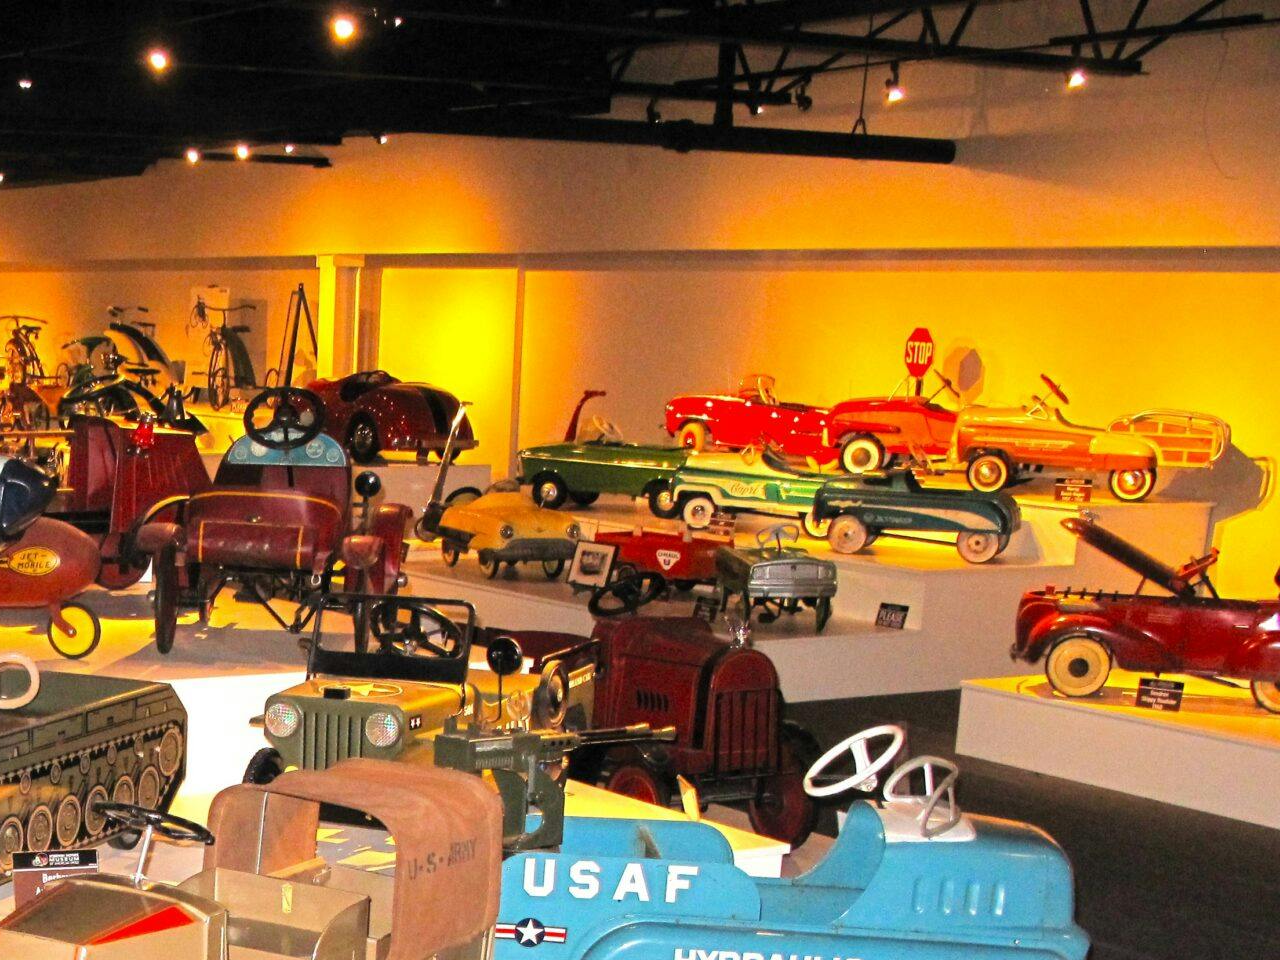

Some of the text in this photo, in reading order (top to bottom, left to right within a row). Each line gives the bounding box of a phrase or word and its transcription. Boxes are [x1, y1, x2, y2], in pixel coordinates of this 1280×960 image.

[906, 341, 932, 364] STOP
[729, 483, 761, 495] Capri
[523, 857, 699, 903] USAF
